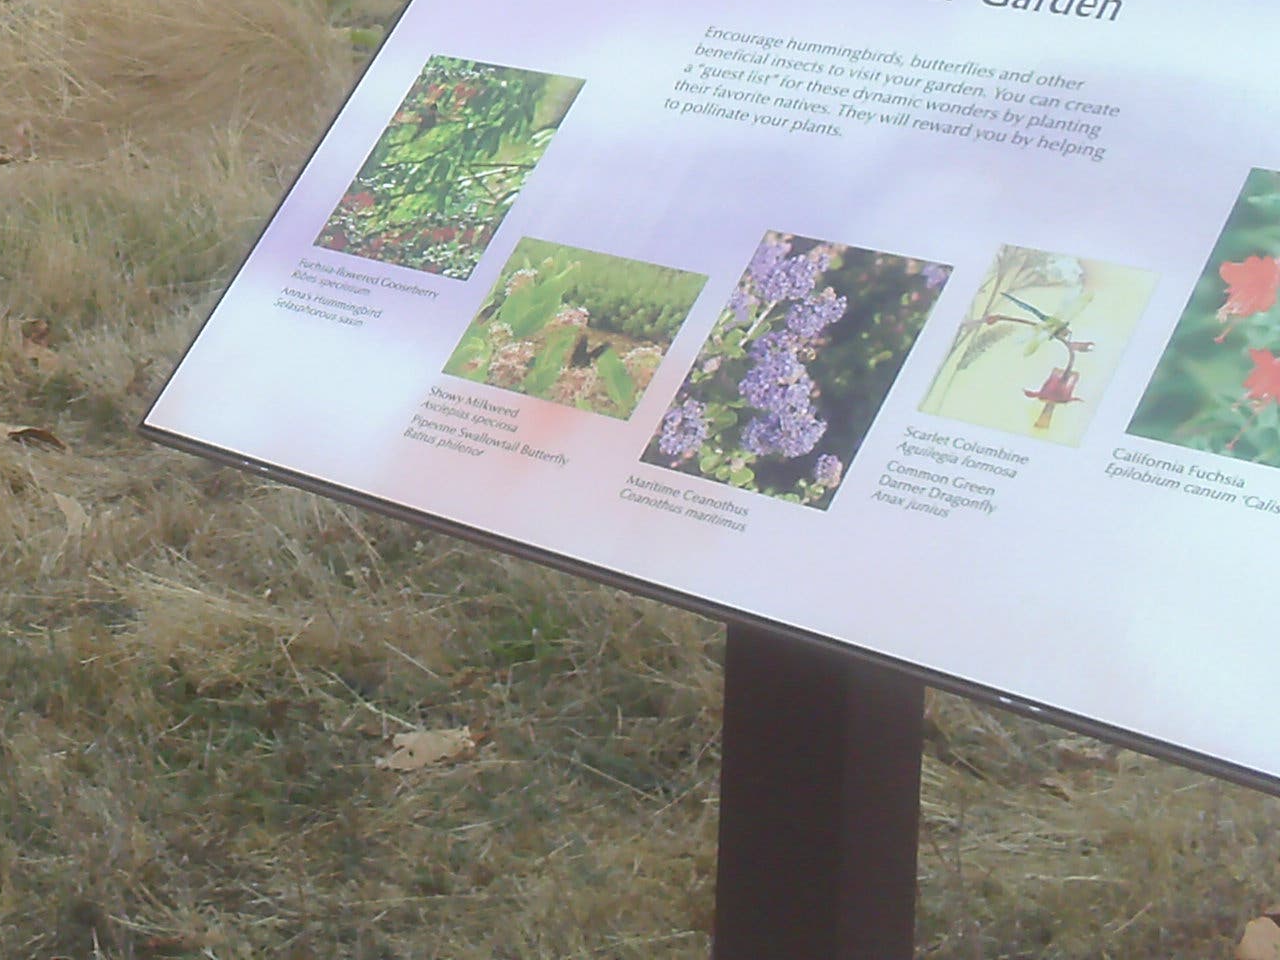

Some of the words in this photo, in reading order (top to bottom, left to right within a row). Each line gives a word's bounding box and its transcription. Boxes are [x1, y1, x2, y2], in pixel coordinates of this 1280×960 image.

[704, 25, 784, 51] Encourage
[786, 36, 904, 66] hummingbirds,
[910, 54, 995, 78] butterflies
[999, 68, 1033, 84] and
[1036, 74, 1085, 90] other
[694, 43, 768, 65] beneficial
[771, 57, 823, 74] insects
[828, 67, 844, 77] to
[849, 68, 881, 85] visit
[883, 74, 922, 88] your
[924, 80, 986, 99] garden.
[994, 88, 1026, 103] You
[1029, 95, 1060, 108] can
[1064, 100, 1120, 117] create
[664, 98, 680, 110] to
[681, 102, 750, 122] pollinate
[752, 115, 789, 129] your
[790, 119, 843, 137] plants.
[674, 79, 711, 95] their
[712, 84, 770, 105] favorite
[774, 98, 831, 115] natives.
[838, 104, 876, 125] They
[880, 114, 910, 129] will
[912, 117, 972, 138] reward
[975, 129, 1007, 143] you
[1010, 131, 1033, 148] by
[1037, 136, 1106, 161] helping
[684, 63, 693, 73] a
[779, 77, 804, 89] for
[806, 80, 849, 98] these
[853, 88, 922, 110] dynamic
[925, 102, 999, 120] wonders
[1002, 108, 1024, 128] by
[1026, 114, 1102, 139] planting
[429, 385, 464, 403] Showy
[466, 396, 520, 418] Milkweed
[458, 427, 519, 452] Swallowtail
[520, 444, 569, 467] Butterfly
[904, 426, 950, 442] Scarlet
[952, 437, 1030, 465] Columbine
[887, 460, 949, 484] Common
[952, 477, 995, 496] Green
[961, 455, 1017, 479] formosa
[1105, 462, 1180, 489] Epilobium
[1183, 483, 1237, 503] canum
[1112, 448, 1185, 474] California
[1188, 465, 1246, 488] Fuchsia
[619, 488, 682, 514] Ceanothus
[685, 508, 746, 532] maritimus
[626, 476, 680, 497] Maritime
[682, 489, 749, 517] Ceanothus
[871, 490, 906, 506] Anax
[905, 500, 950, 518] junius
[879, 474, 926, 495] Darner
[928, 487, 997, 514] Dragonfly
